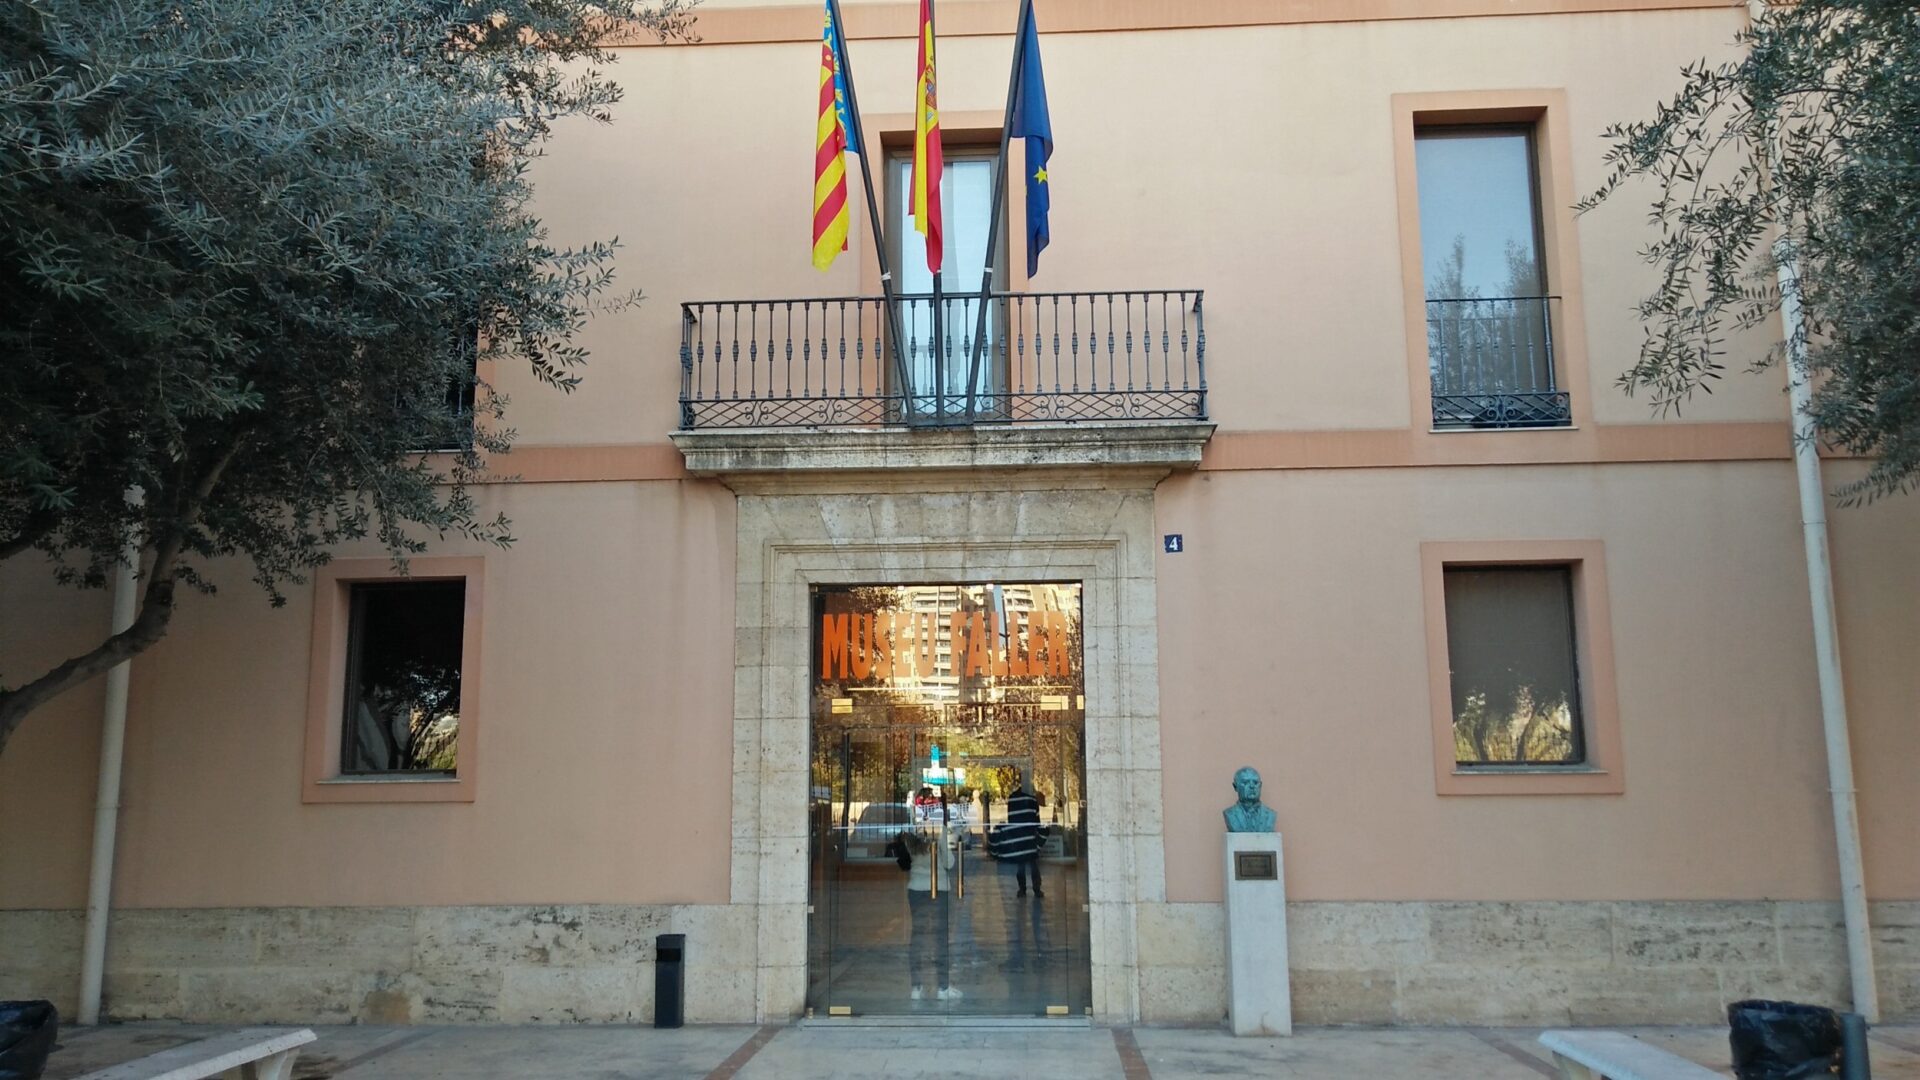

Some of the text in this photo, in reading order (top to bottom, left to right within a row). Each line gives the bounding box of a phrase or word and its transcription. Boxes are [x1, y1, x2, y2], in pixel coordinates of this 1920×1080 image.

[1169, 536, 1179, 551] 4
[822, 611, 1069, 680] MUSEU FALLER
